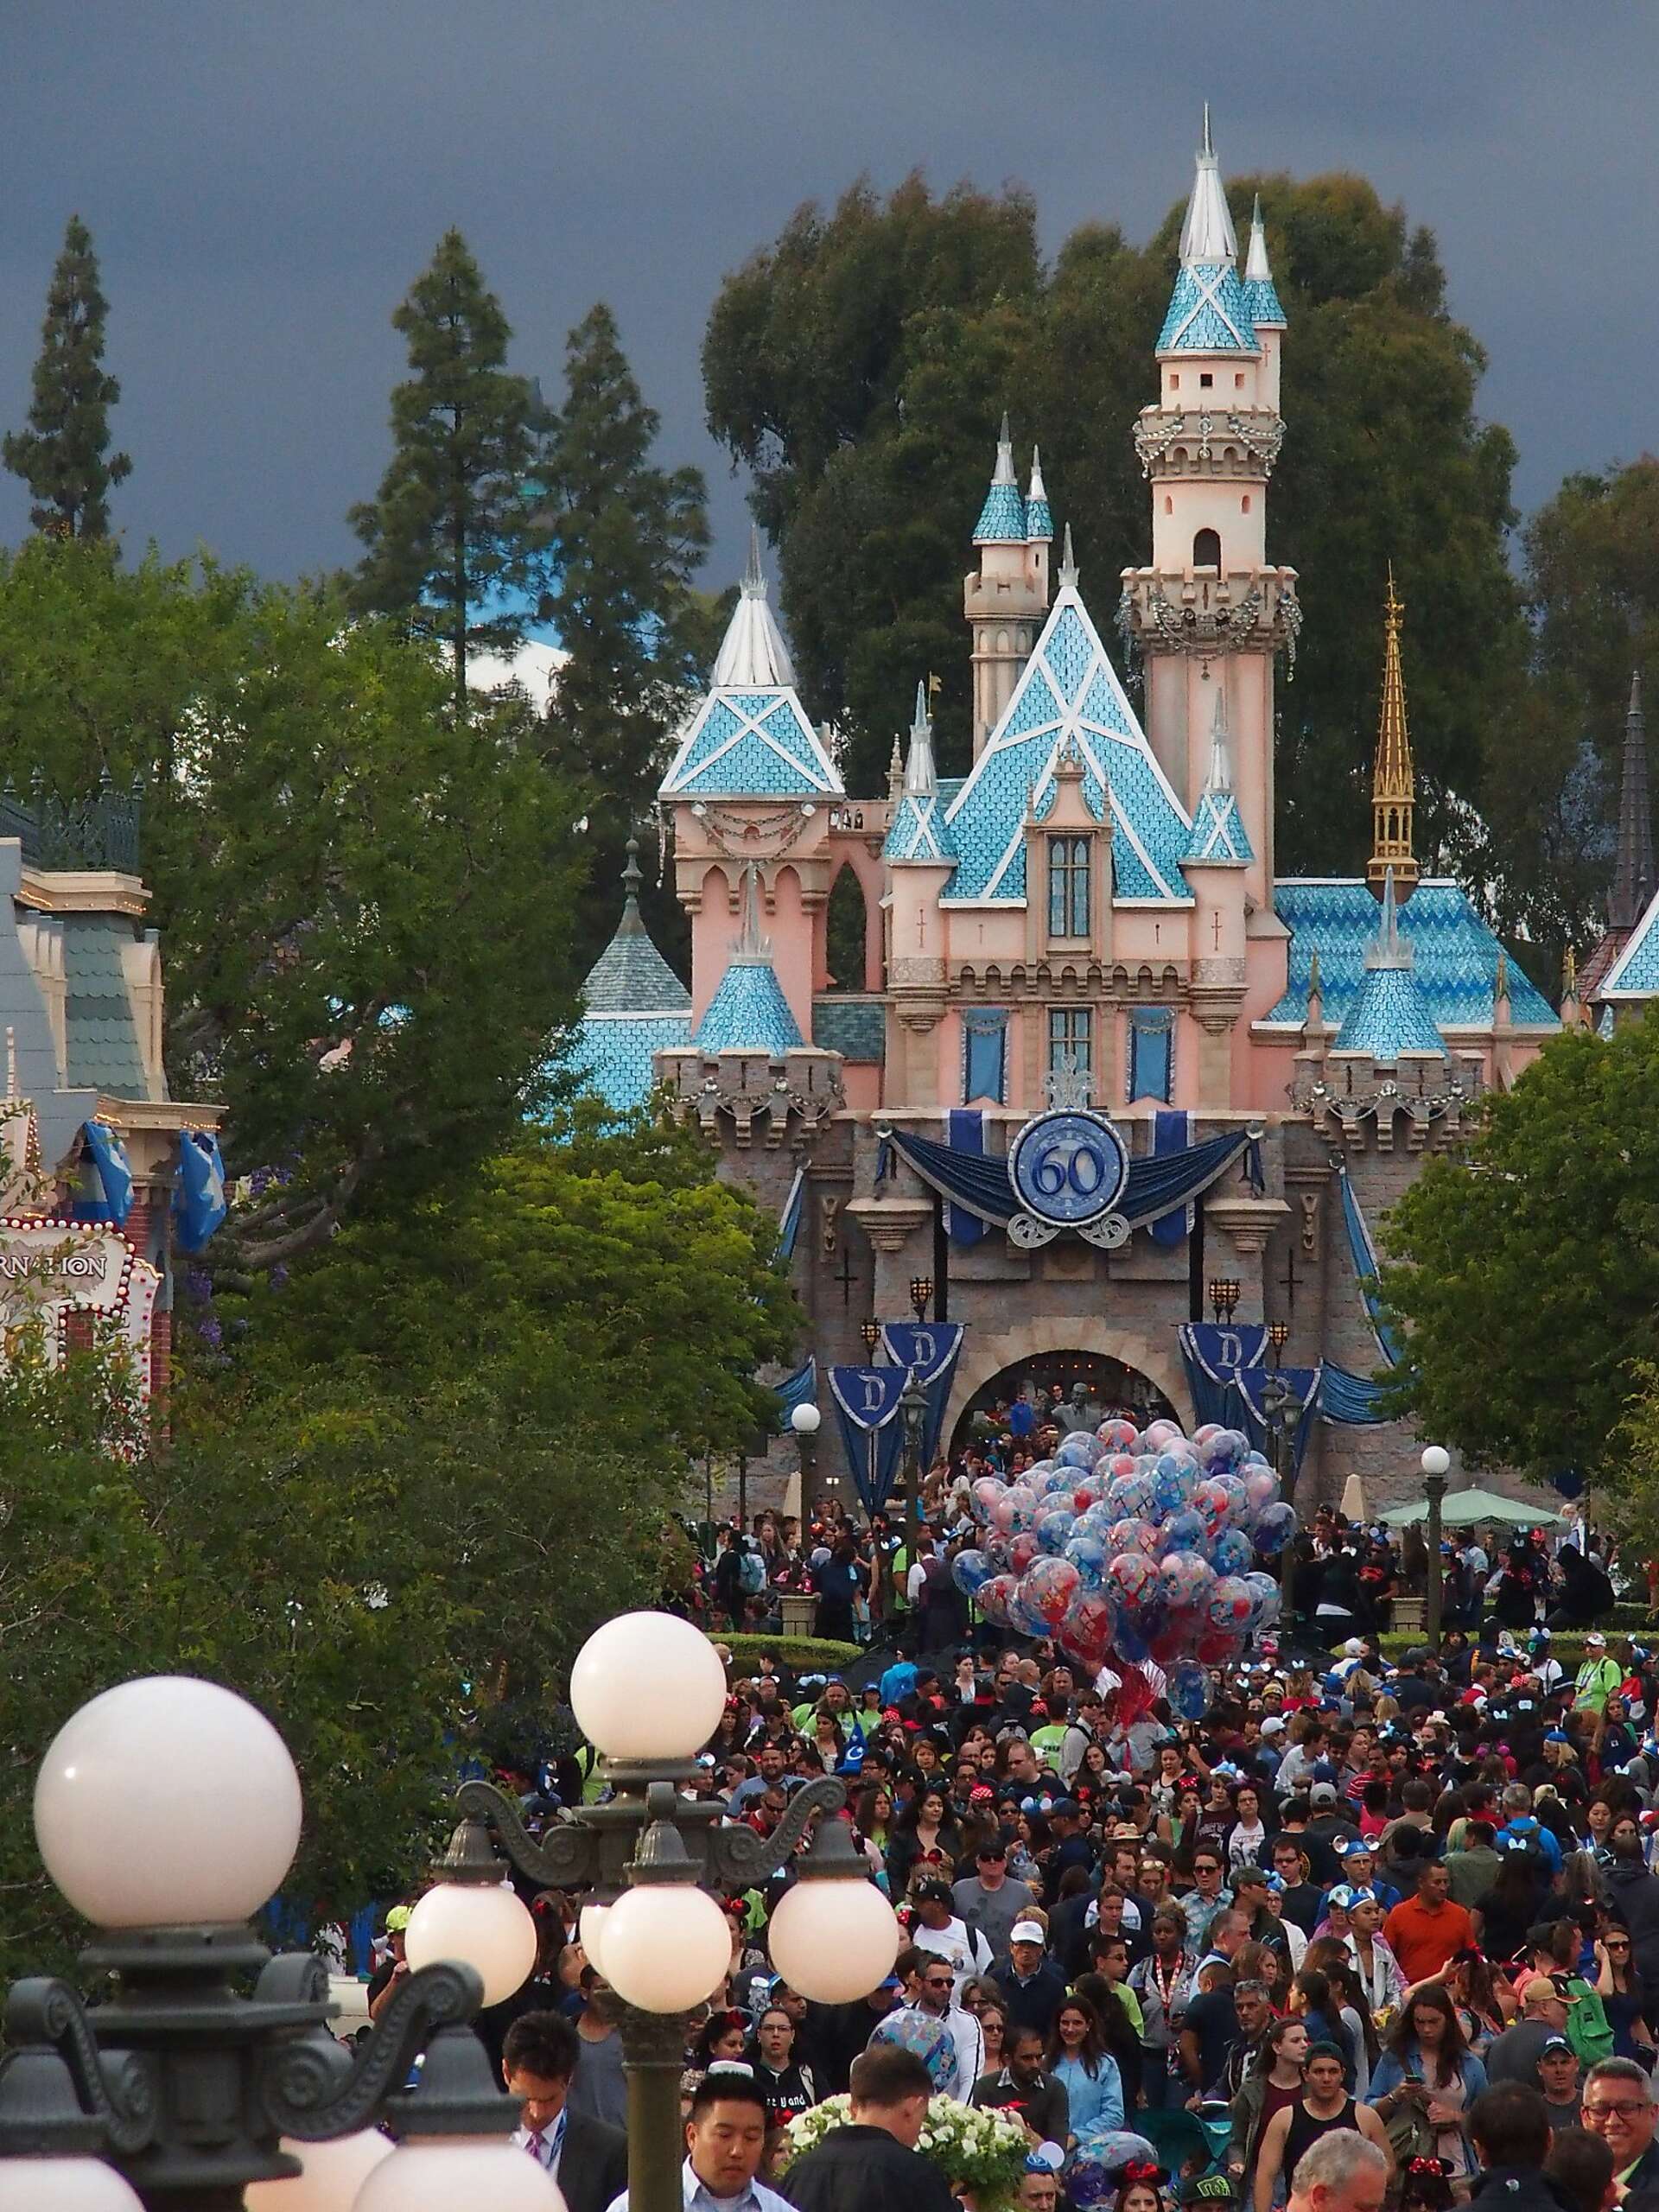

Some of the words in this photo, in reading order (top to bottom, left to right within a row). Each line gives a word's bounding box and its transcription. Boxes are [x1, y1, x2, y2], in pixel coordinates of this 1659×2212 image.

[1030, 1145, 1105, 1196] 60
[910, 1331, 937, 1366] D
[1217, 1331, 1243, 1368] D
[856, 1373, 886, 1412] D
